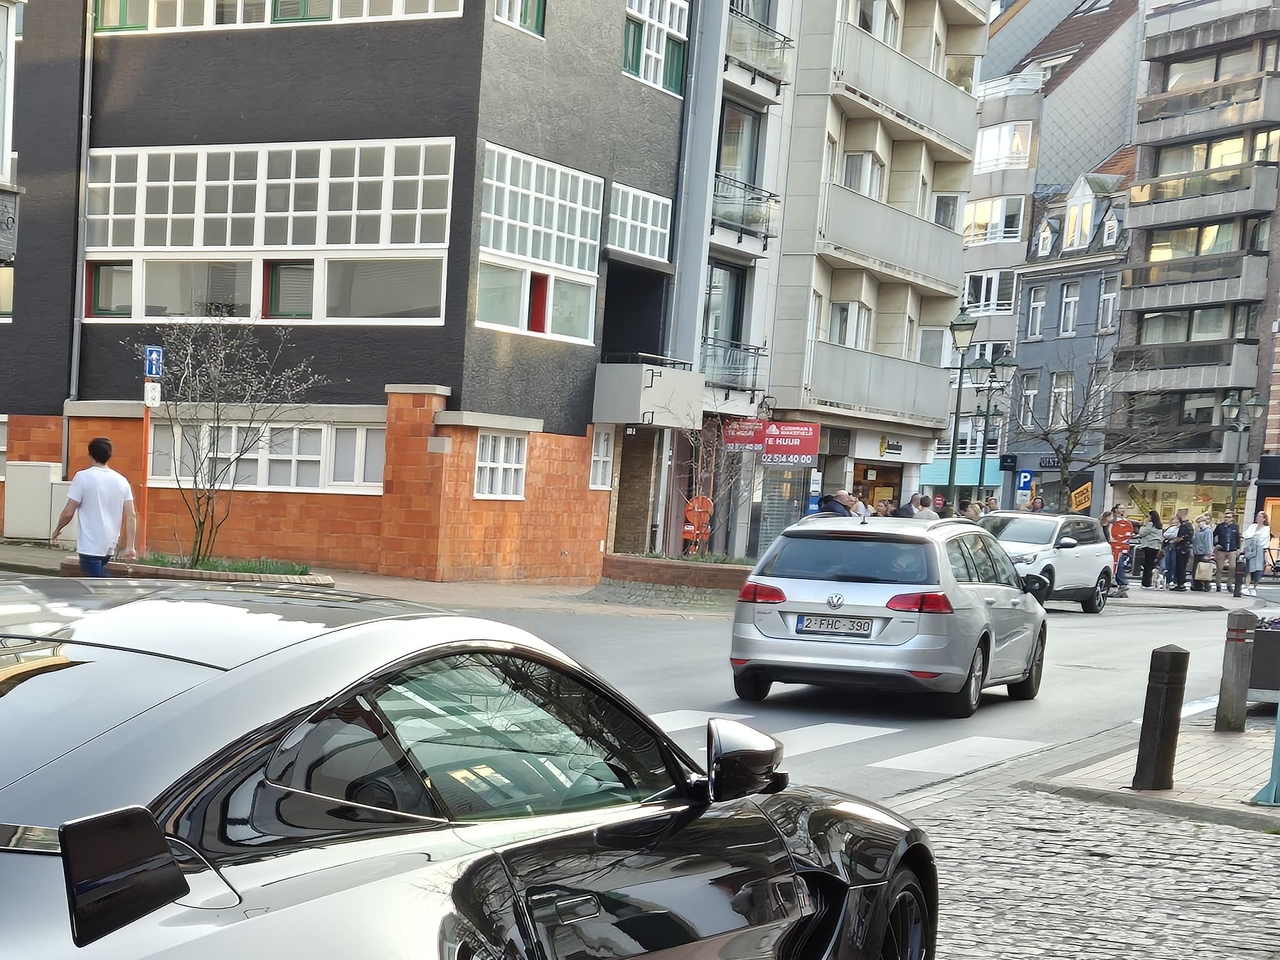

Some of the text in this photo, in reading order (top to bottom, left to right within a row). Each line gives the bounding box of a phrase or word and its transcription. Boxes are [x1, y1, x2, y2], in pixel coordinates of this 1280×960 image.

[775, 438, 801, 446] HUUR
[761, 453, 773, 462] 02
[787, 454, 799, 463] 40
[800, 455, 812, 464] 00
[1019, 472, 1031, 487] P
